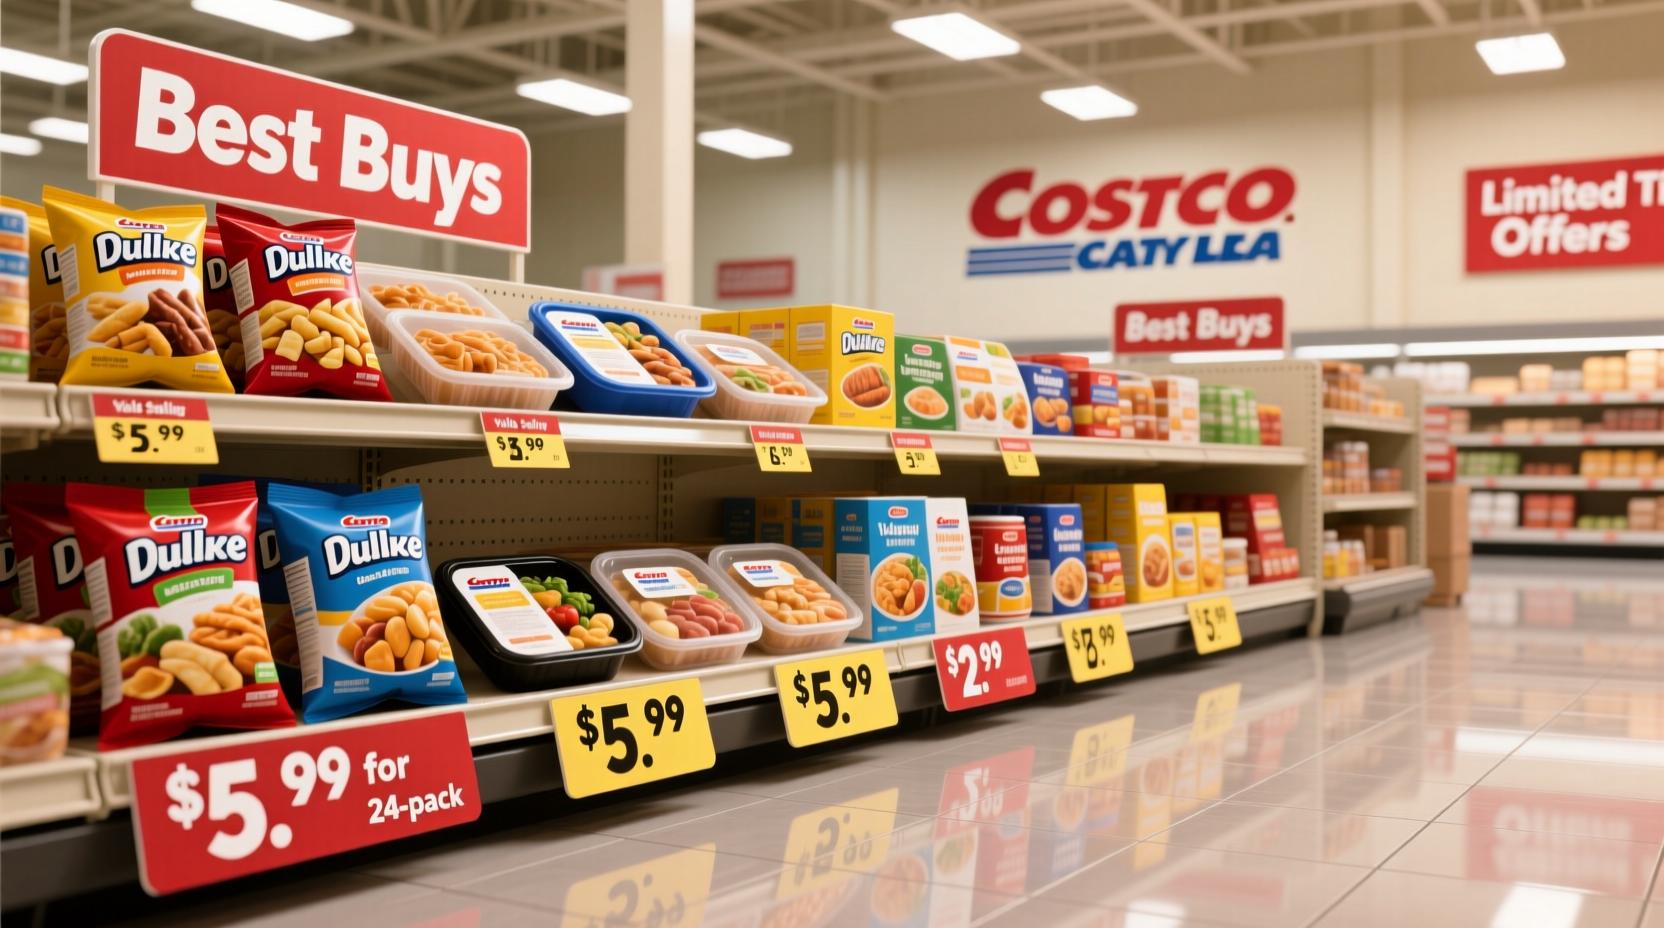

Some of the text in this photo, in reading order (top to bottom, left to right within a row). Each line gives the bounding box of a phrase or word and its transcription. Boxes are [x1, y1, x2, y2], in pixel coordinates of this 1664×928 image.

[135, 66, 503, 227] Best Buys
[1481, 170, 1628, 216] Limited
[96, 232, 197, 268] Dullke
[1077, 237, 1190, 269] CATY
[1491, 212, 1630, 258] Offers
[265, 244, 353, 279] Dullke
[1124, 306, 1272, 347] Best Buys
[111, 422, 184, 453] $5.99
[125, 529, 247, 584] Dullke
[324, 529, 423, 576] Dullke
[945, 640, 1002, 698] $2.99
[793, 663, 872, 729] $5.99
[576, 694, 685, 774] $5.99
[164, 746, 410, 860] $5.99 for
[367, 782, 465, 824] 24-pack
